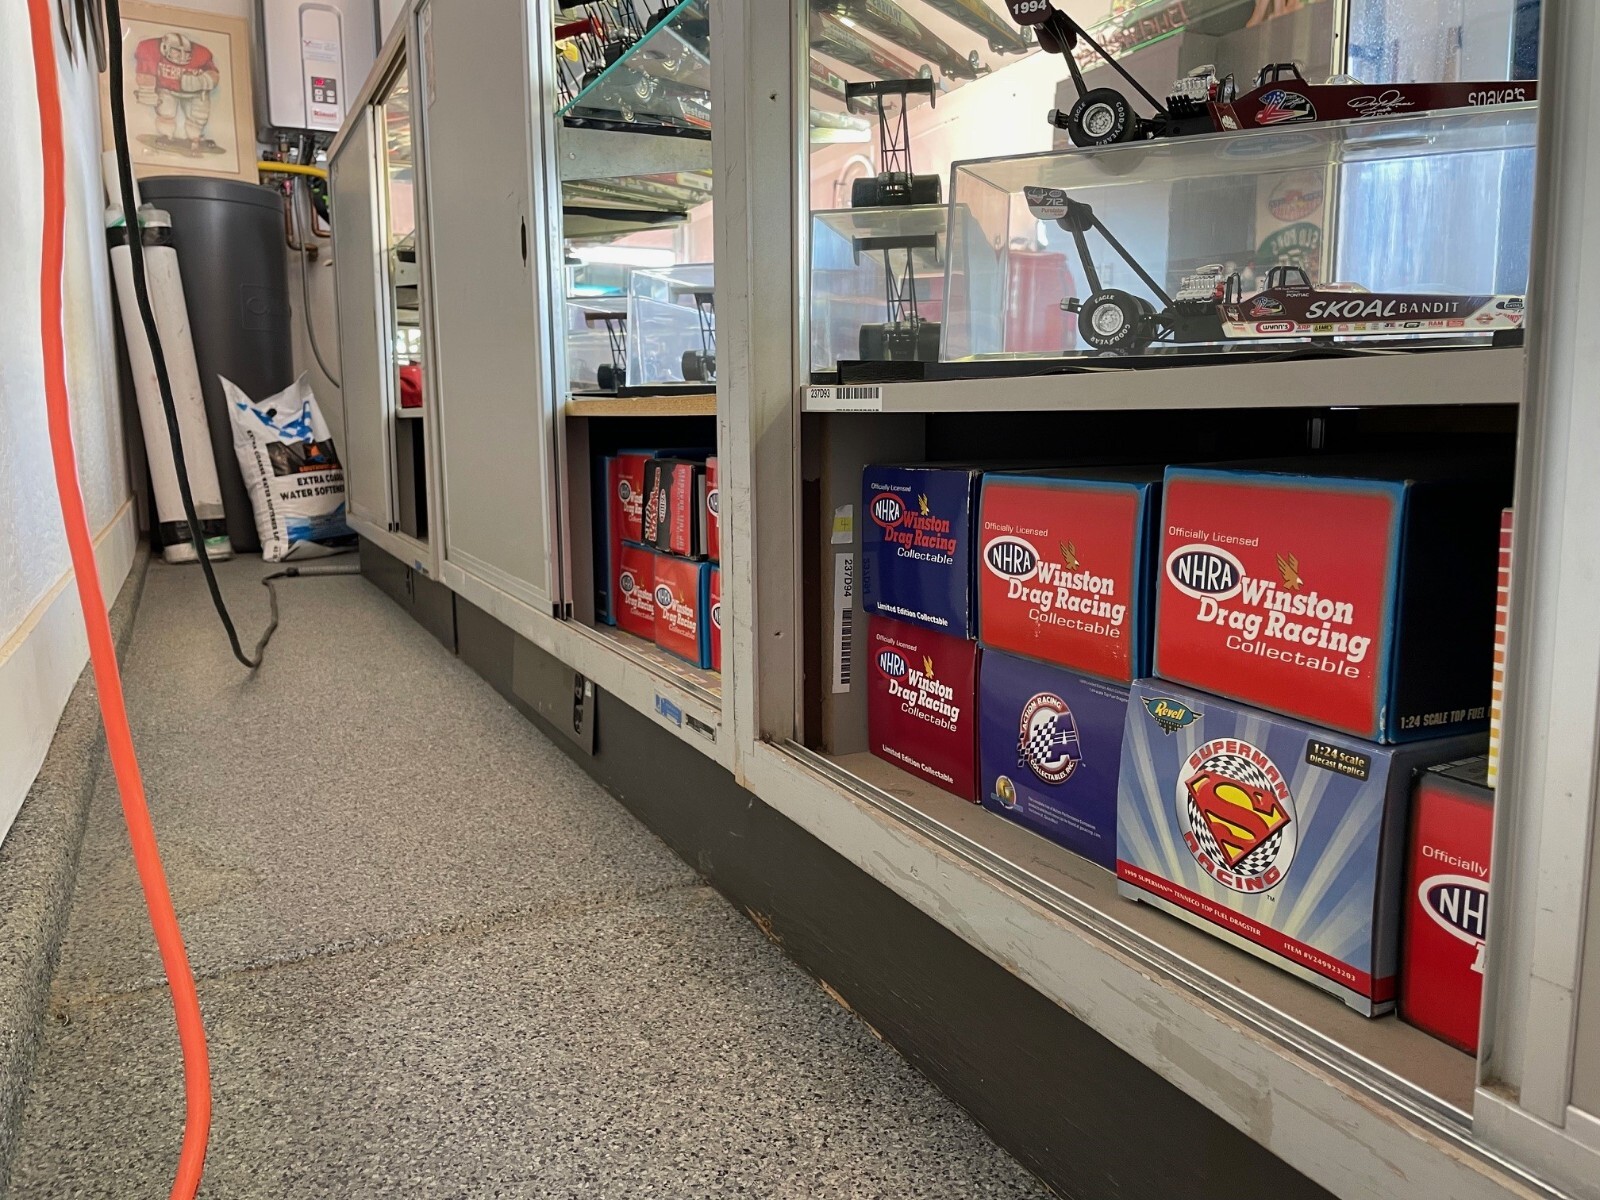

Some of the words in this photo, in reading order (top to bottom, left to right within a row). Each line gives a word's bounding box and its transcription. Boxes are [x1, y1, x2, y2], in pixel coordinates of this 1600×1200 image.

[1013, 2, 1047, 15] 1994
[1305, 299, 1396, 319] SKOAL
[1399, 302, 1460, 314] BANDIT
[810, 388, 830, 399] 237D93
[297, 475, 325, 486] EXTRA
[280, 489, 313, 501] WATER
[875, 498, 900, 521] NHRA
[903, 510, 950, 533] Winston
[884, 527, 912, 549] Drag
[914, 531, 956, 554] Racing
[984, 521, 1014, 534] Officially
[1016, 526, 1048, 537] Licensed
[1168, 526, 1209, 541] Officially
[1213, 532, 1259, 547] Licensed
[897, 547, 953, 565] Collectable
[992, 545, 1031, 573] NHRA
[844, 559, 853, 597] 237D94
[1037, 560, 1114, 596] Winston
[1178, 555, 1233, 590] NHRA
[877, 602, 896, 614] Limited
[897, 606, 916, 618] Edition
[916, 611, 948, 626] Collectable
[1008, 578, 1054, 612] Drag
[1056, 587, 1126, 625] Racing
[1241, 576, 1354, 625] Winston
[1029, 608, 1120, 638] Collectable
[1197, 597, 1263, 640] Drag
[1264, 612, 1371, 662] Racing
[880, 652, 905, 676] NHRA
[1226, 635, 1360, 679] Collectable
[908, 669, 953, 700] Winston
[888, 679, 917, 706] Drag
[918, 692, 960, 722] Racing
[1022, 701, 1037, 730] ACTION
[1037, 696, 1062, 709] RACING
[1154, 701, 1185, 720] Revell
[901, 703, 957, 732] Collectable
[1401, 716, 1420, 729] 1:24
[1423, 712, 1448, 726] SCALE
[1450, 710, 1466, 722] TOP
[1468, 707, 1485, 720] FUEL
[882, 744, 901, 760] Limited
[901, 753, 920, 769] Edition
[921, 761, 954, 784] Collectable
[1310, 754, 1336, 768] Diecast
[1337, 763, 1365, 777] Replica
[1314, 743, 1338, 759] 1:24
[1339, 752, 1365, 767] Scale
[1189, 740, 1289, 800] SUPERMAN
[1184, 831, 1280, 890] RACING
[1422, 845, 1488, 877] Officially
[1124, 869, 1137, 878] 1999
[1174, 891, 1200, 907] TENNECO
[1201, 903, 1213, 913] TOP
[1214, 909, 1228, 920] FUEL
[1229, 916, 1261, 936] DRAGSTER
[1440, 888, 1486, 936] NH
[1284, 942, 1302, 956] ITEM
